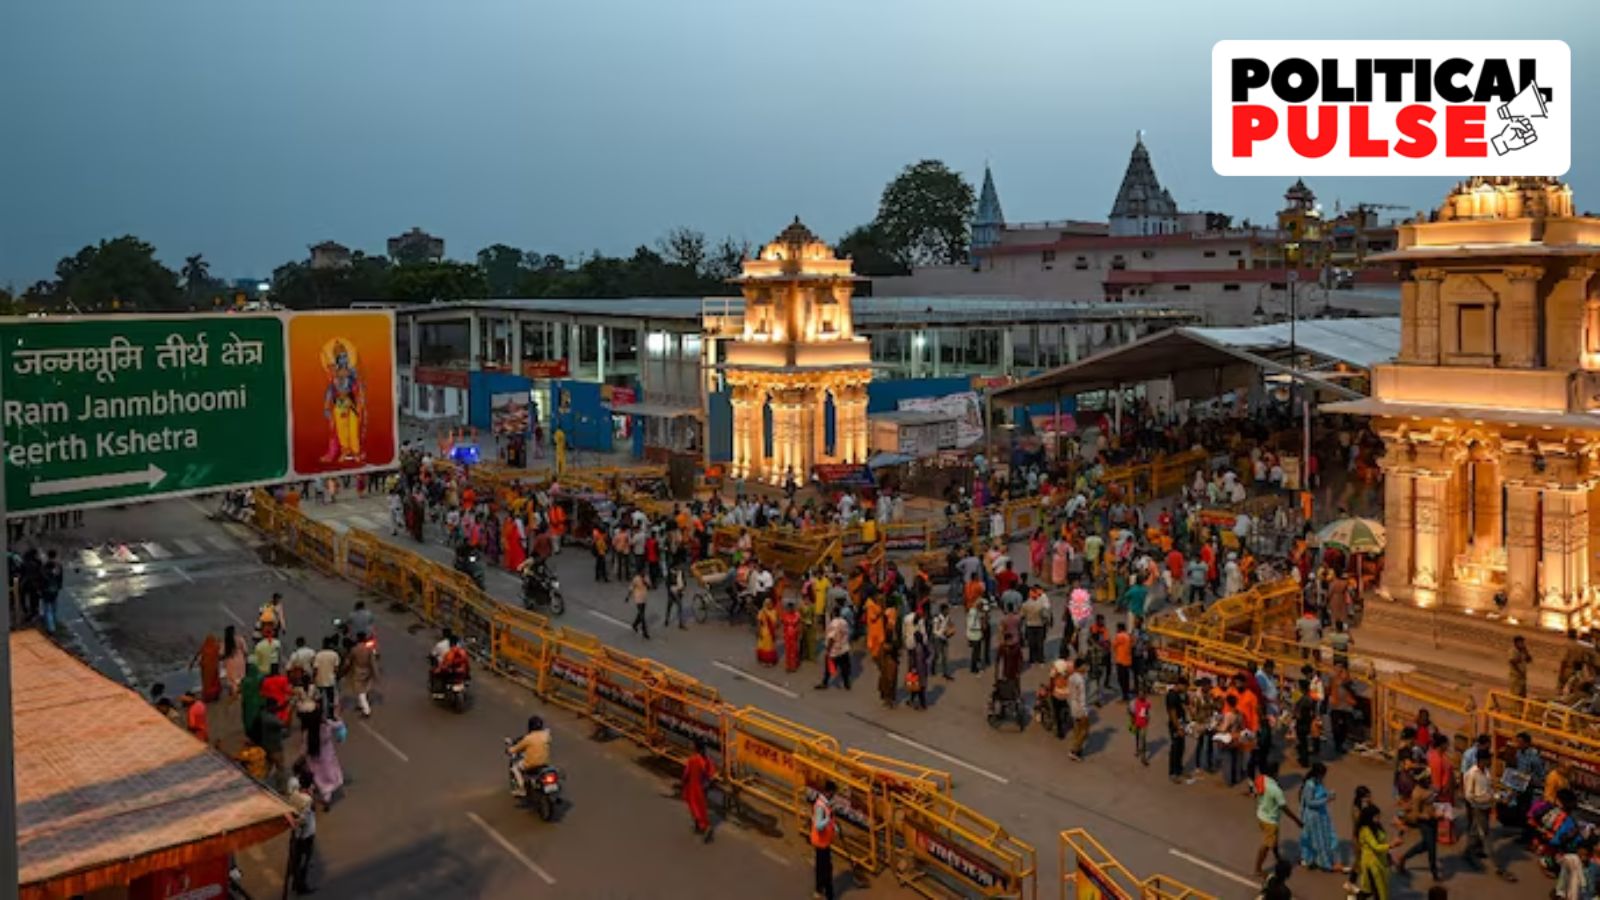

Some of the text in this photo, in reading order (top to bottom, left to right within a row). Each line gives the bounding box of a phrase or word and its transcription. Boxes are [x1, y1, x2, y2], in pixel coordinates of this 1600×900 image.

[12, 331, 264, 382] जन्मभूमि तीर्थ क्षेत्र
[4, 384, 247, 427] Ram Janmbhoomi
[96, 426, 198, 456] Kshetra
